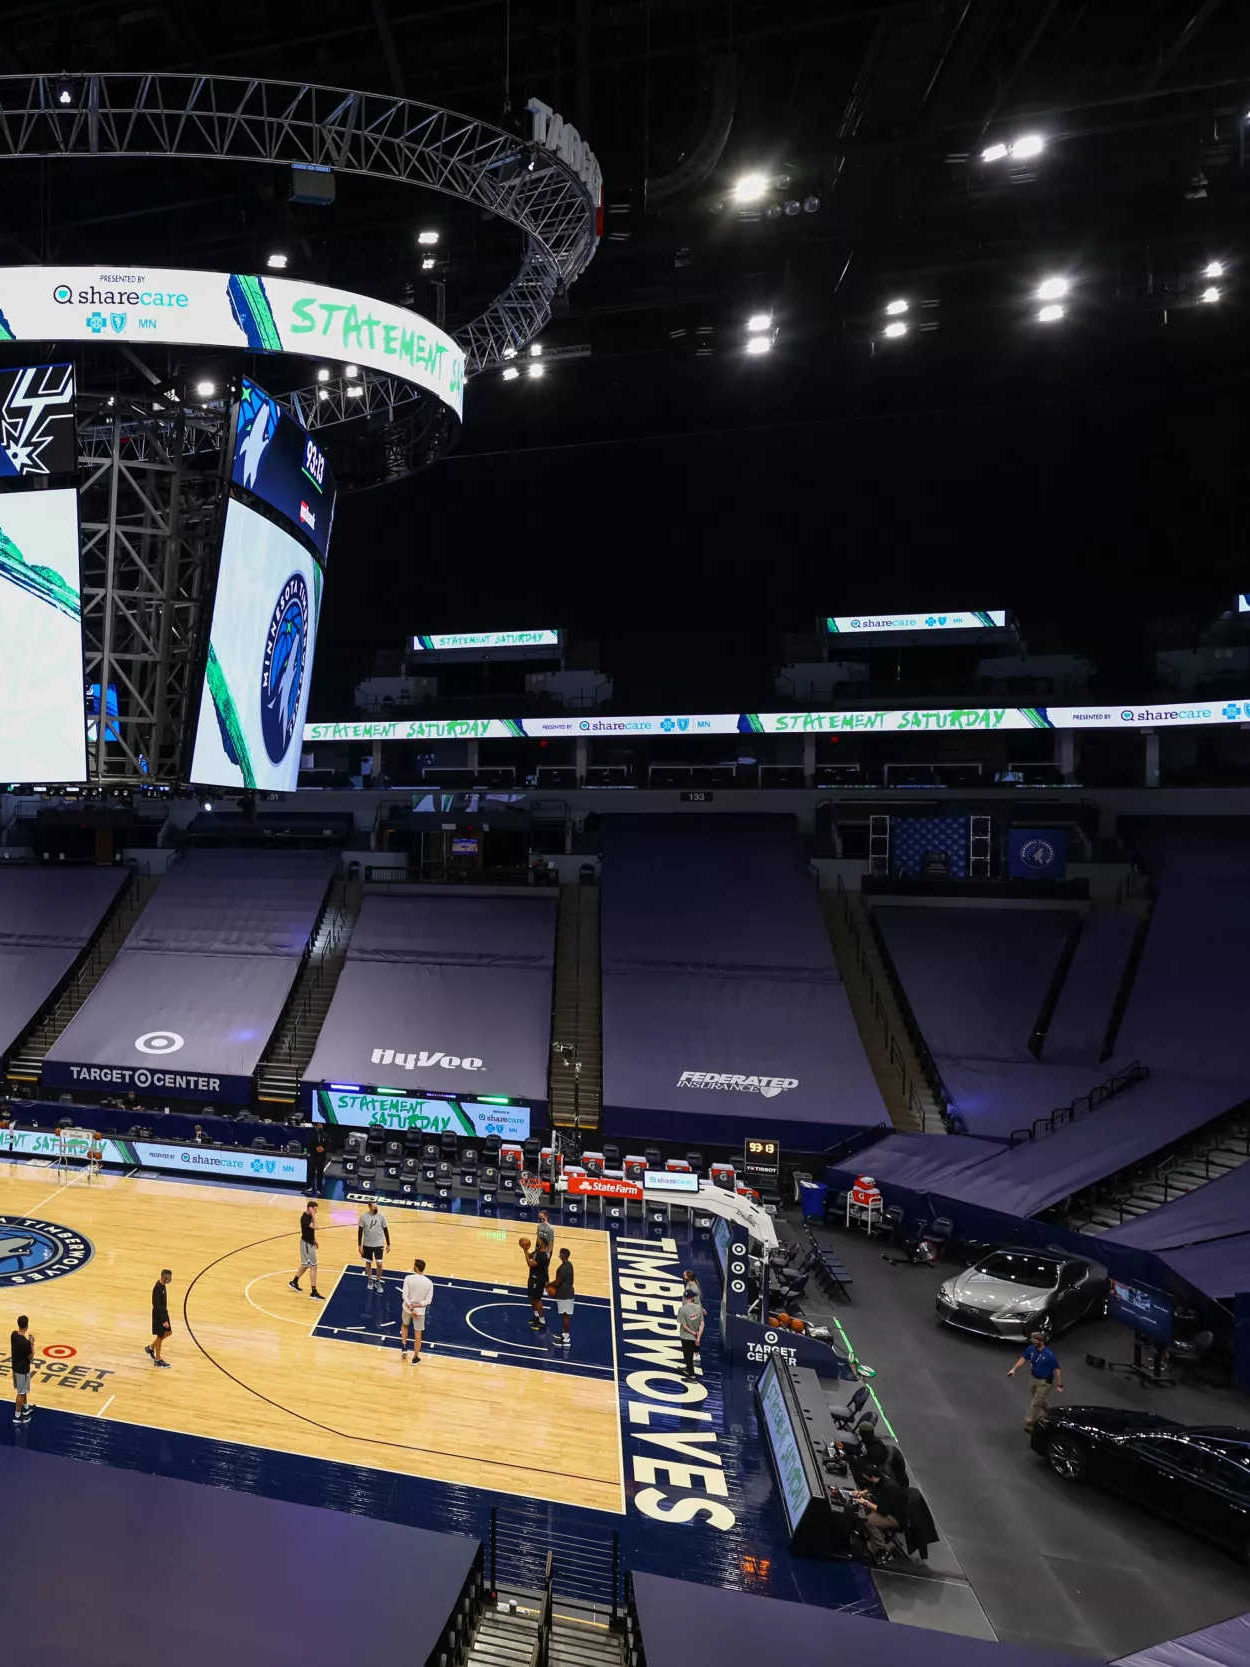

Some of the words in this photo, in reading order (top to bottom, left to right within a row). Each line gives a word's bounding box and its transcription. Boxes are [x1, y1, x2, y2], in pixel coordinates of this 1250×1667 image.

[100, 275, 132, 284] PRESENTED
[134, 275, 145, 284] BY
[78, 286, 188, 308] sharecare
[138, 317, 157, 329] MN
[290, 298, 449, 380] STATEMENT
[306, 440, 325, 484] 93:13
[862, 617, 916, 629] sharecare
[439, 635, 492, 646] STATEMENT
[494, 631, 544, 644] SATURDAY
[775, 711, 891, 730] STATEMENT
[897, 709, 1006, 729] SATURDAY
[1137, 709, 1212, 722] sharecare
[311, 722, 401, 739] STATEMENT
[406, 720, 491, 737] SATURDAY
[592, 719, 652, 732] sharecare
[697, 720, 710, 728] MN
[689, 793, 704, 801] 133
[70, 1066, 132, 1083] TARGET
[153, 1073, 220, 1091] CENTER
[676, 1079, 760, 1093] INSURANCE
[679, 1071, 799, 1089] FEDERATED
[338, 1095, 429, 1114] STATEMENT
[368, 1112, 451, 1132] SATURDAY
[486, 1114, 524, 1124] sharecare
[192, 1154, 243, 1169] sharecare
[282, 1164, 295, 1172] MN
[11, 1219, 86, 1284] TIMBERWOLVES
[747, 1343, 797, 1358] TARGET
[616, 1236, 737, 1531] TIMBERWOLVES
